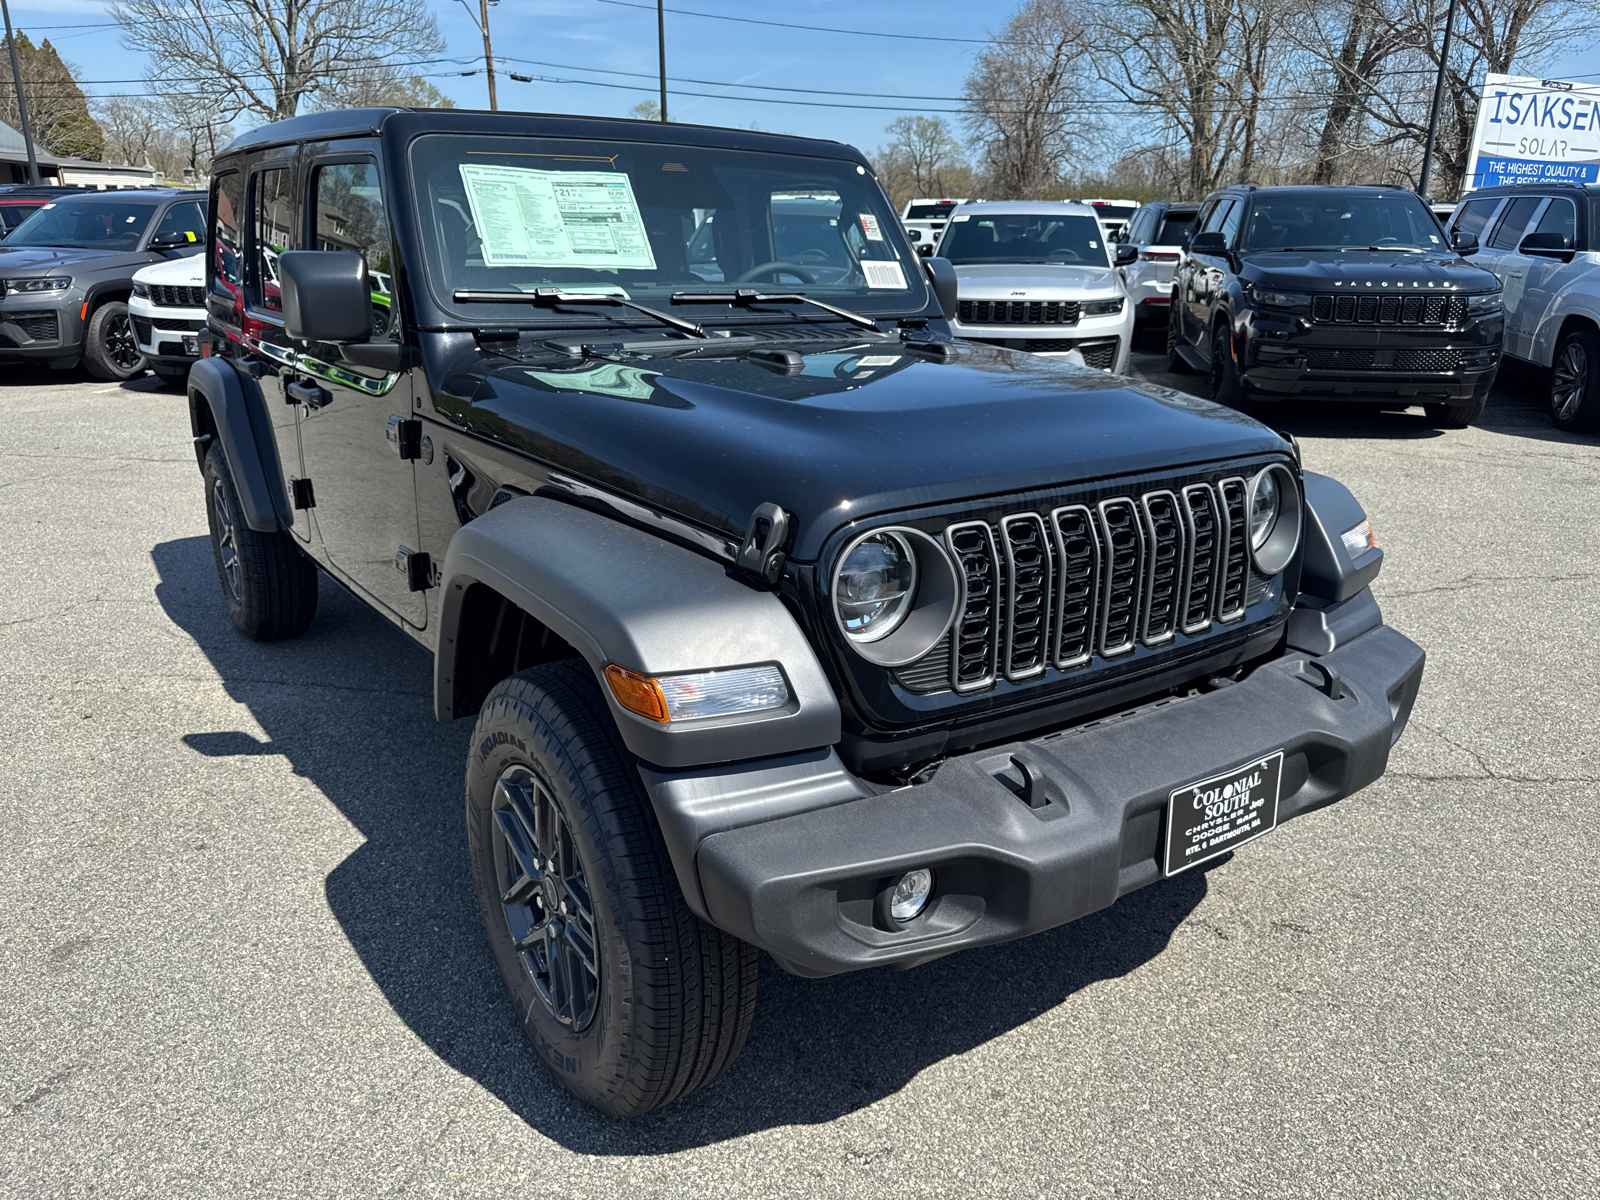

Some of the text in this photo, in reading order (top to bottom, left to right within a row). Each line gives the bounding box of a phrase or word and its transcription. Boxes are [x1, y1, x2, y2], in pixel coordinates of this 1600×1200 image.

[1518, 137, 1568, 157] SOLAR
[1488, 161, 1587, 178] THE HIGHEST QUALITY &
[1498, 176, 1514, 186] THE
[1193, 772, 1262, 810] COLONIAL
[1185, 797, 1265, 836] CHRYSLER Jeep
[1204, 790, 1251, 821] SOUTH
[1191, 811, 1257, 843] DODGE RAM
[1251, 818, 1261, 828] MA
